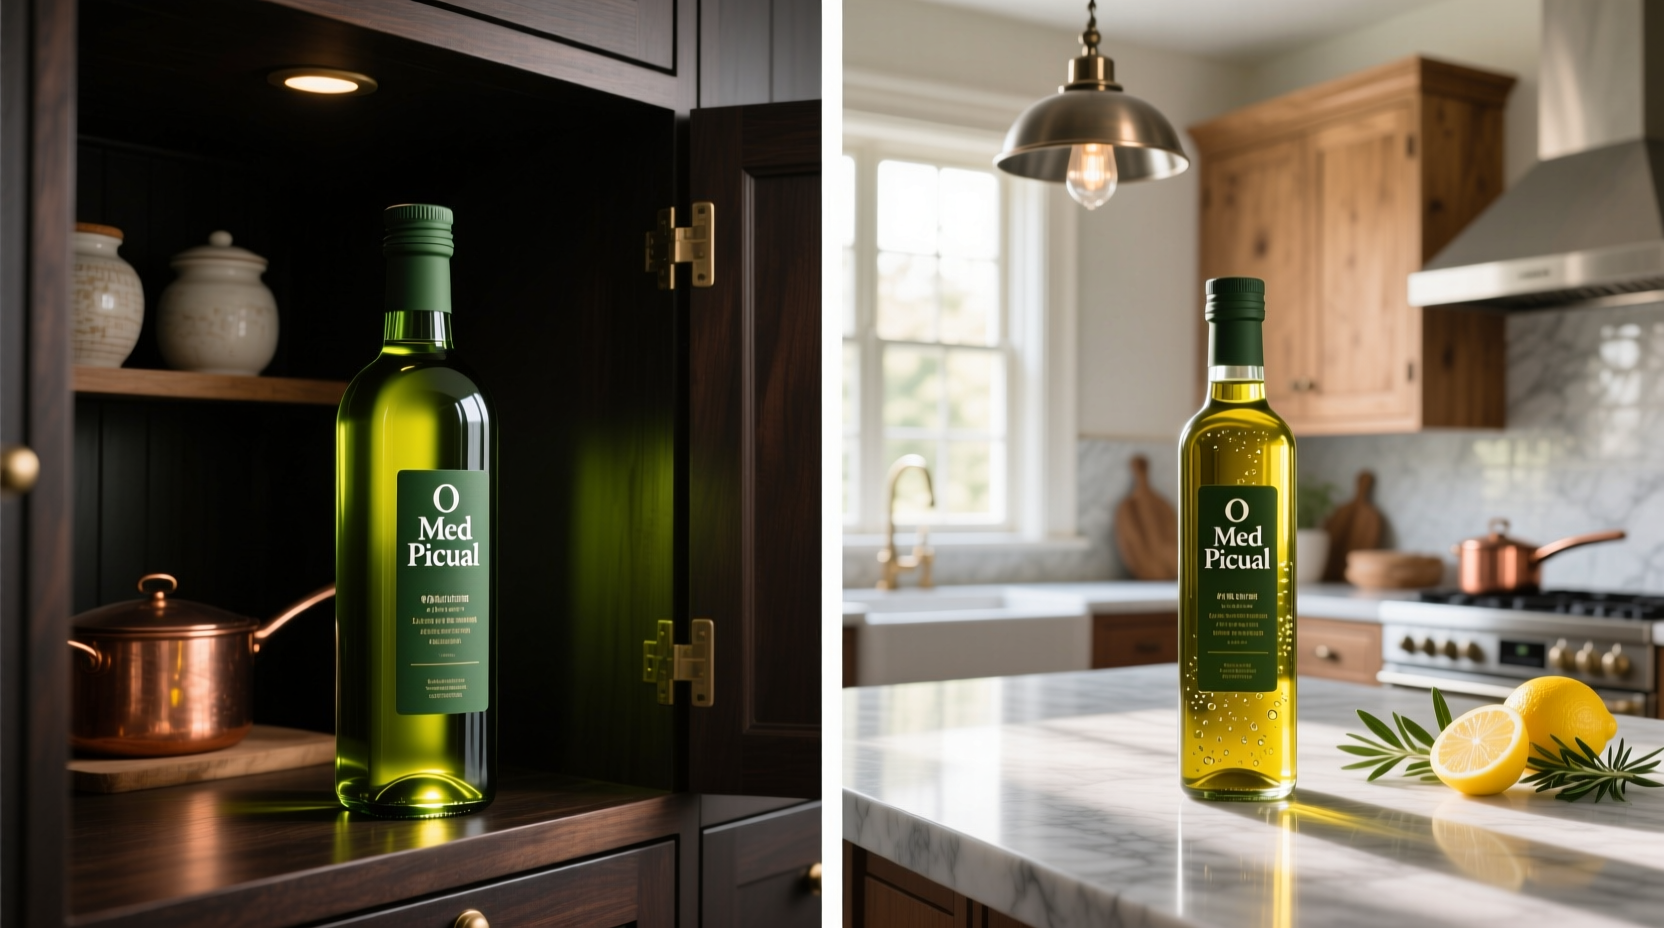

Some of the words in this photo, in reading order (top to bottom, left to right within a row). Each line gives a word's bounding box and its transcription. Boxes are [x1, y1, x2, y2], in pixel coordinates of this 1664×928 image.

[433, 484, 460, 513] O
[1225, 498, 1249, 523] O
[418, 515, 473, 541] Med
[1213, 525, 1263, 547] Med
[407, 542, 480, 567] Picual
[1204, 547, 1270, 569] Picual
